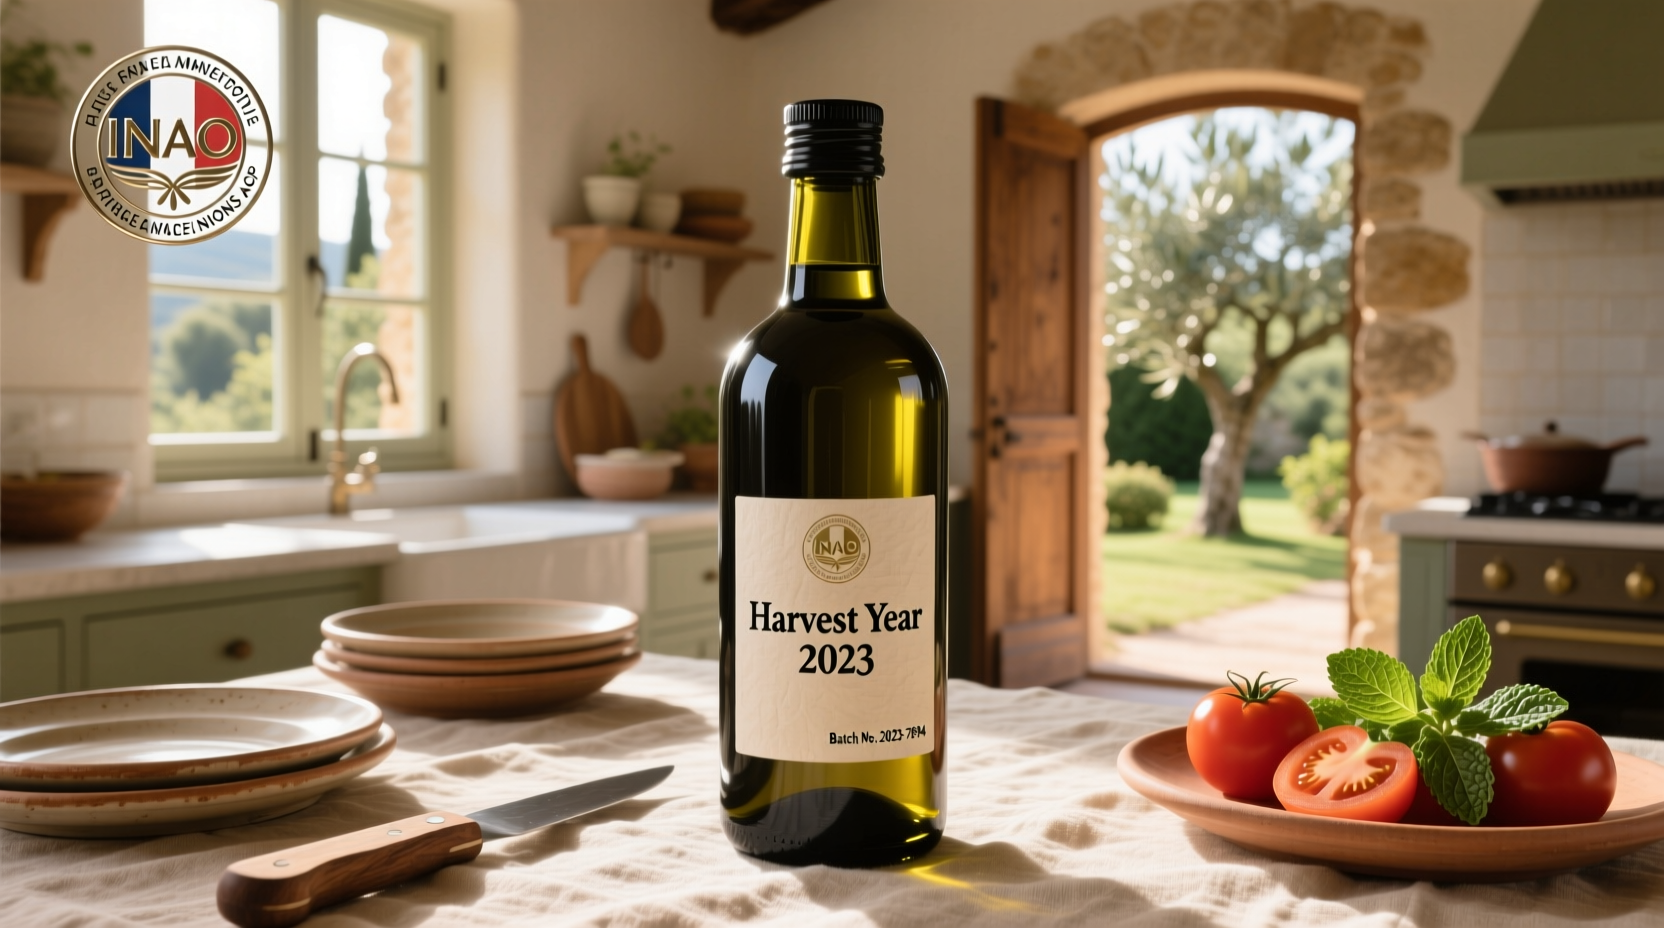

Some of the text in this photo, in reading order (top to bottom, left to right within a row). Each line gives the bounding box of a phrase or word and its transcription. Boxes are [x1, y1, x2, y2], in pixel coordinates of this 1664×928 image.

[749, 600, 923, 634] Harvest Year
[799, 643, 874, 676] 2023
[829, 731, 859, 744] Batch
[861, 731, 878, 744] No.
